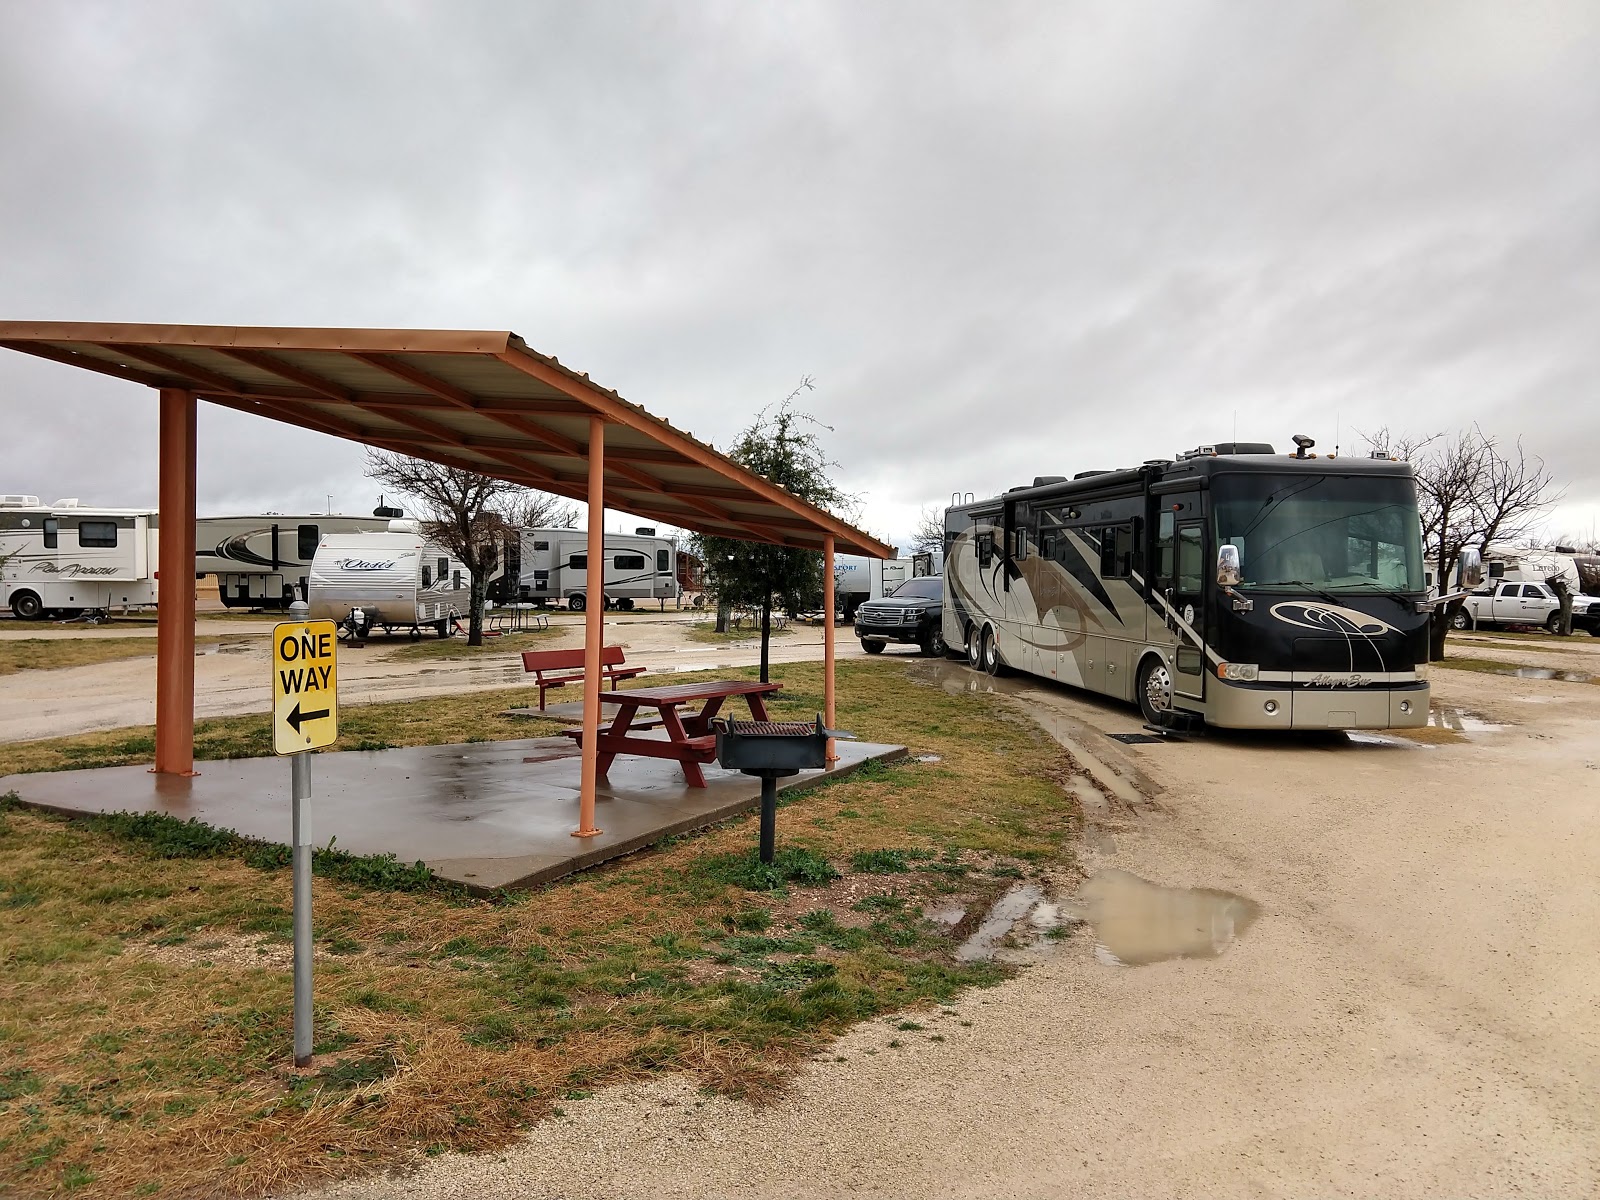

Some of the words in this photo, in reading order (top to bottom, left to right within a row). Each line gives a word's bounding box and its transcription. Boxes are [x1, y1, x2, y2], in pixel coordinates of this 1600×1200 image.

[345, 558, 396, 569] Oasis
[1532, 563, 1560, 572] Laredo
[280, 633, 332, 662] ONE
[279, 665, 333, 695] WAY
